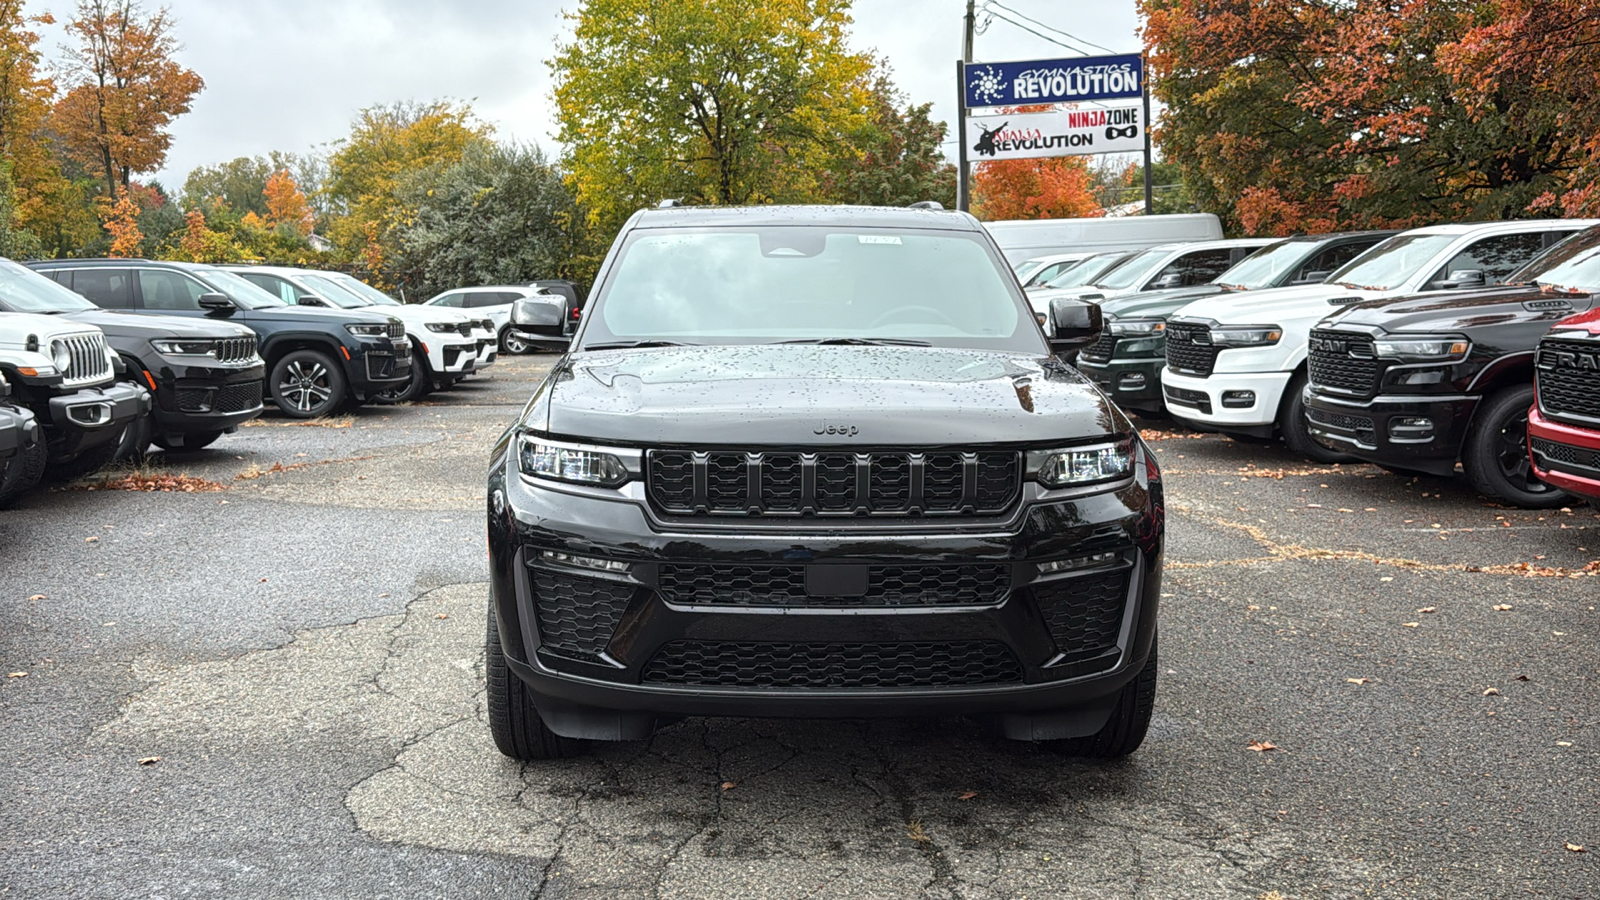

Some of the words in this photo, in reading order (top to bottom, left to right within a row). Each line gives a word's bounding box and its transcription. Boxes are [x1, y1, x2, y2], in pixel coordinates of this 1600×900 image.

[1018, 64, 1131, 82] GYMNASTICS
[1013, 71, 1138, 99] REVOLUTION
[1069, 108, 1138, 128] NINJAZONE
[993, 133, 1093, 151] REVOLUTION
[1312, 338, 1347, 352] RAM
[1556, 351, 1600, 370] RA
[813, 420, 859, 437] Jeep
